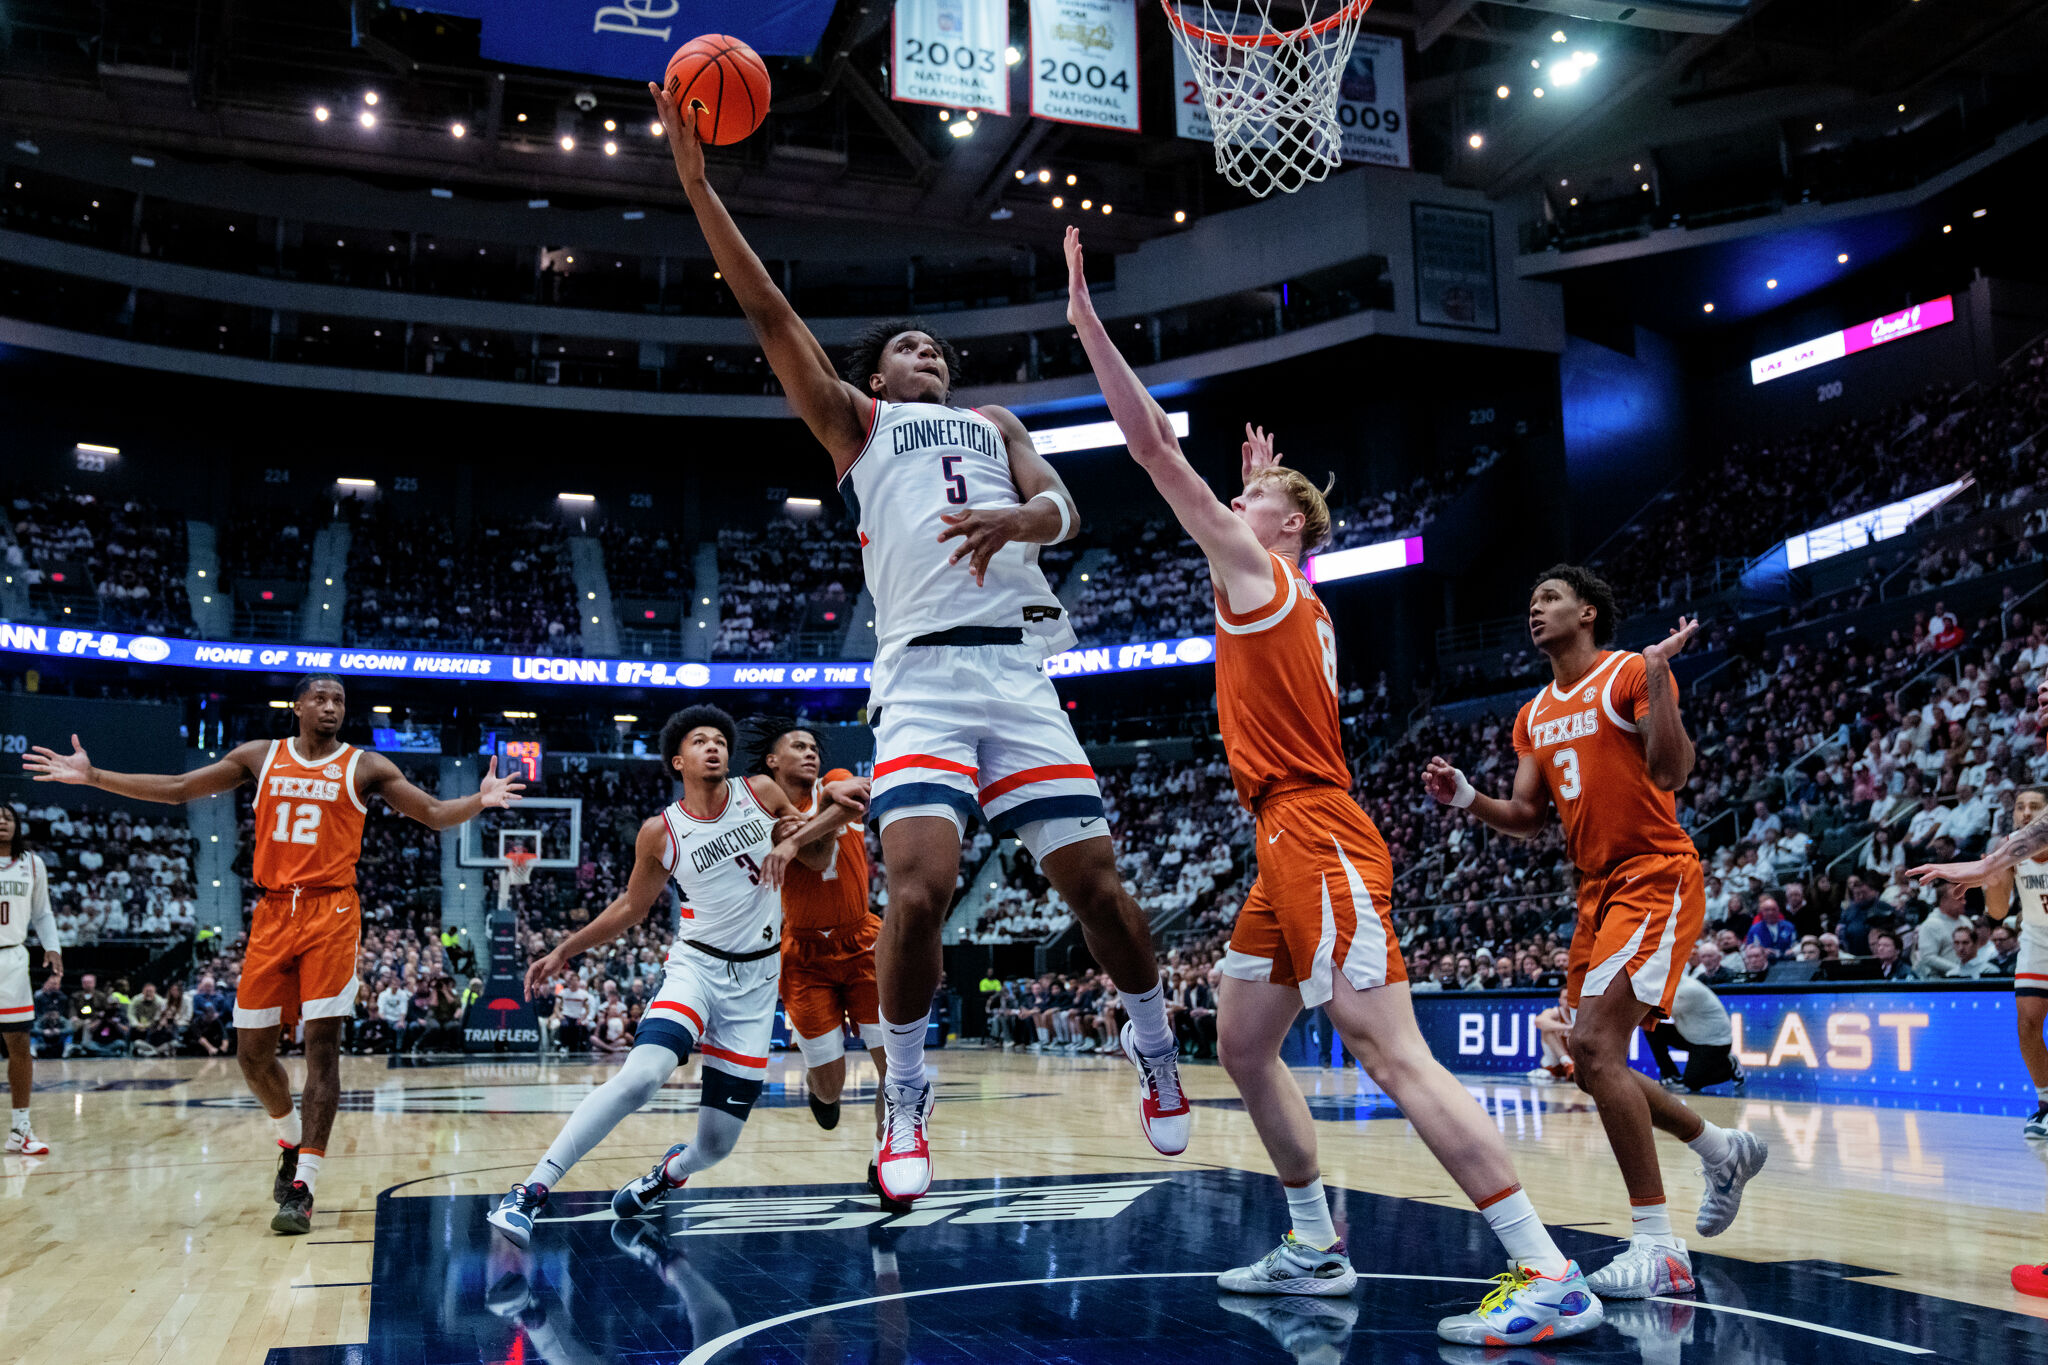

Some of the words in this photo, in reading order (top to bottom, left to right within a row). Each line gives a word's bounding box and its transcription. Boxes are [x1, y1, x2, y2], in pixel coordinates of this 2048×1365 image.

[905, 38, 995, 73] 2003
[914, 70, 987, 89] NATIONAL
[1040, 58, 1129, 93] 2004
[908, 85, 995, 106] CHAMPIONS
[1049, 89, 1121, 109] NATIONAL
[1044, 103, 1127, 125] CHAMPIONS
[1338, 104, 1400, 133] 009
[1342, 131, 1392, 148] ATIONAL
[1342, 147, 1399, 163] AMPIONS
[1817, 381, 1844, 402] 200
[893, 419, 998, 459] CONNECTICUT
[77, 455, 105, 472] 223
[264, 469, 289, 483] 224
[394, 477, 418, 491] 225
[942, 456, 968, 504] 5
[0, 624, 47, 650] NN
[195, 646, 253, 664] HOME
[260, 650, 288, 665] OF
[296, 652, 333, 667] THE
[339, 654, 407, 670] UCONN
[413, 658, 491, 674] HUSKIES
[512, 658, 607, 682] UCONN
[1043, 649, 1110, 677] CONN
[734, 668, 784, 682] HOME
[792, 668, 817, 683] OF
[824, 668, 856, 682] THE
[1532, 707, 1598, 750] TEXAS
[521, 757, 536, 781] 7
[1553, 747, 1581, 800] 3
[269, 776, 340, 802] TEXAS
[272, 801, 322, 845] 12
[690, 819, 768, 874] CONNECTICUT
[735, 852, 762, 887] 3
[463, 1028, 539, 1042] TRAVELERS
[1458, 1012, 1537, 1058] BUI
[1730, 1011, 1929, 1072] LAST
